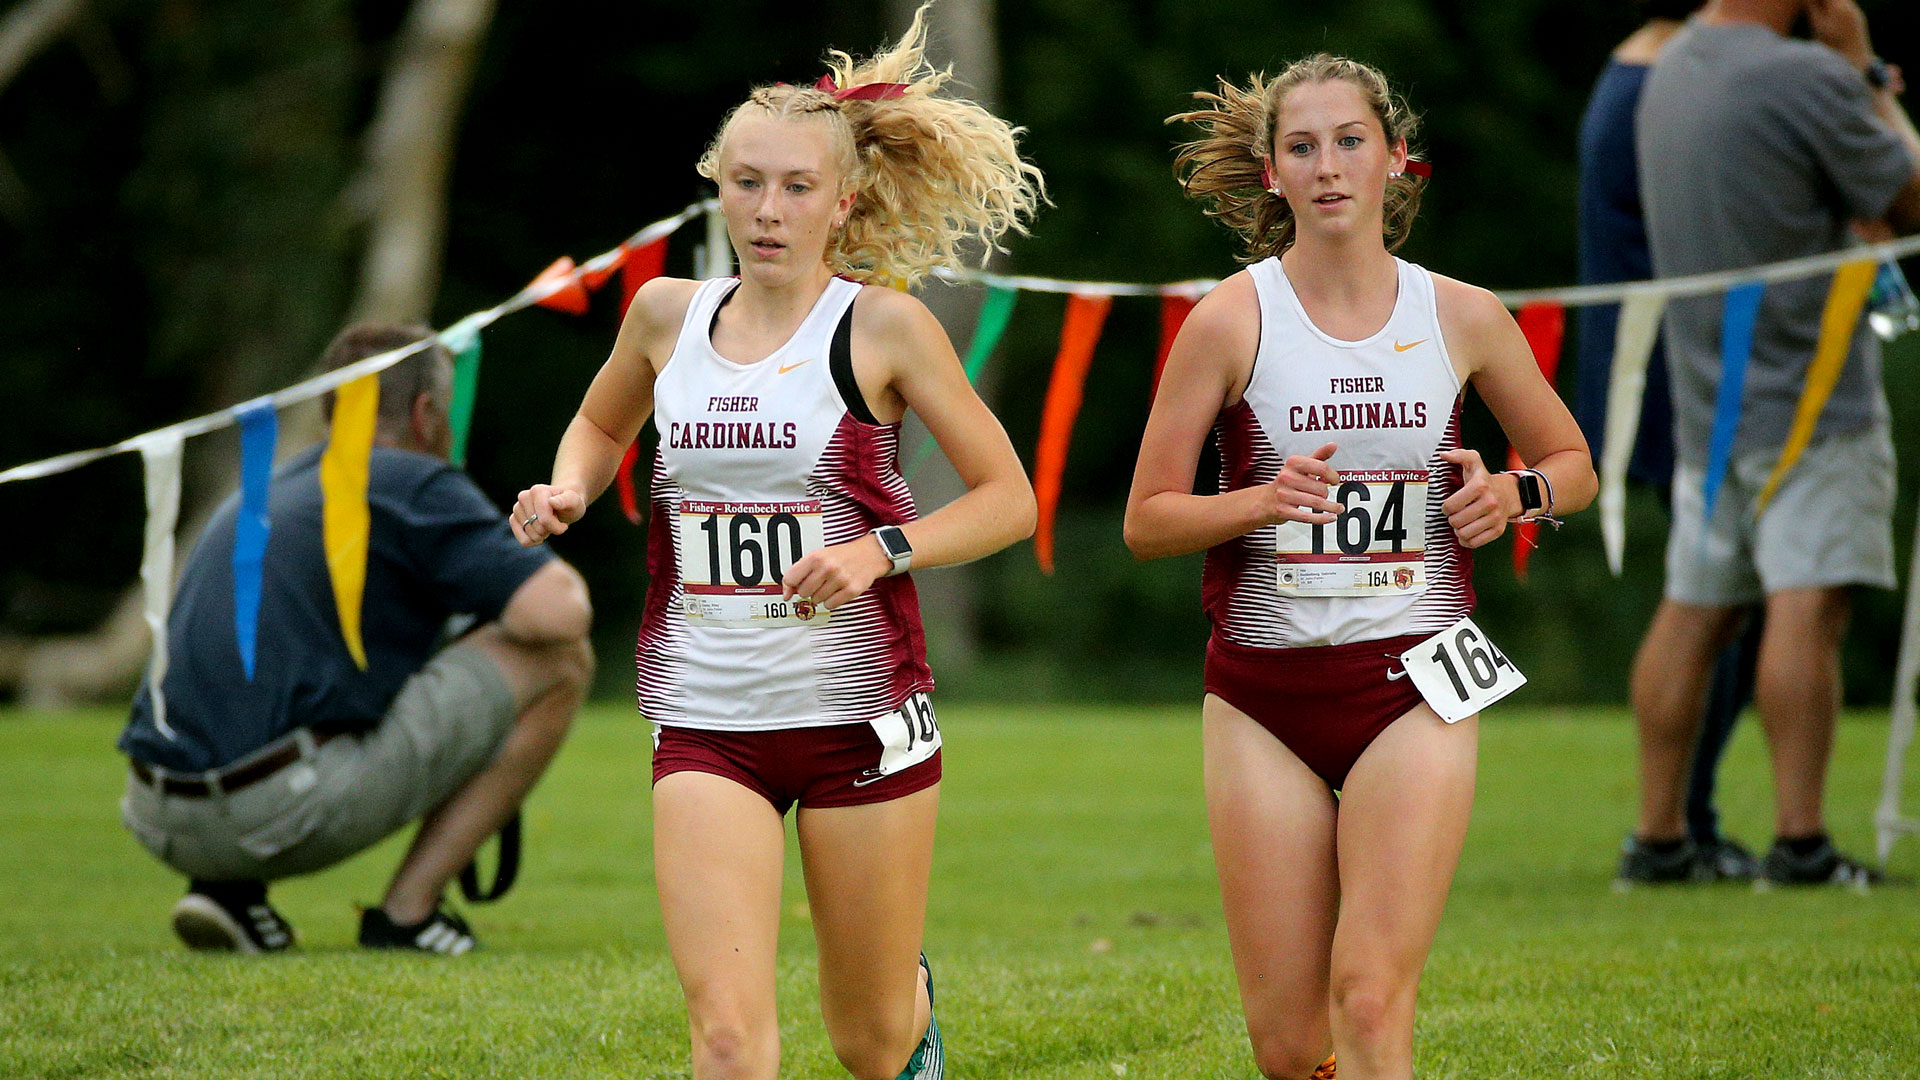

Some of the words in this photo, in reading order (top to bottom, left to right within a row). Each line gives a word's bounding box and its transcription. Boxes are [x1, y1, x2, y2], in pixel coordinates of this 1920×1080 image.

[1330, 376, 1385, 394] FISHER
[707, 396, 759, 412] FISHER
[1289, 401, 1427, 432] CARDINALS
[669, 422, 797, 449] CARDINALS
[1340, 471, 1389, 481] odenbeck
[1391, 471, 1419, 481] Invite
[689, 502, 715, 513] Fisher
[724, 503, 778, 513] Rodenbeck
[780, 503, 810, 513] Invite
[701, 513, 803, 587] 160
[1368, 570, 1389, 587] 164
[764, 602, 788, 618] 160
[893, 695, 939, 752] 16
